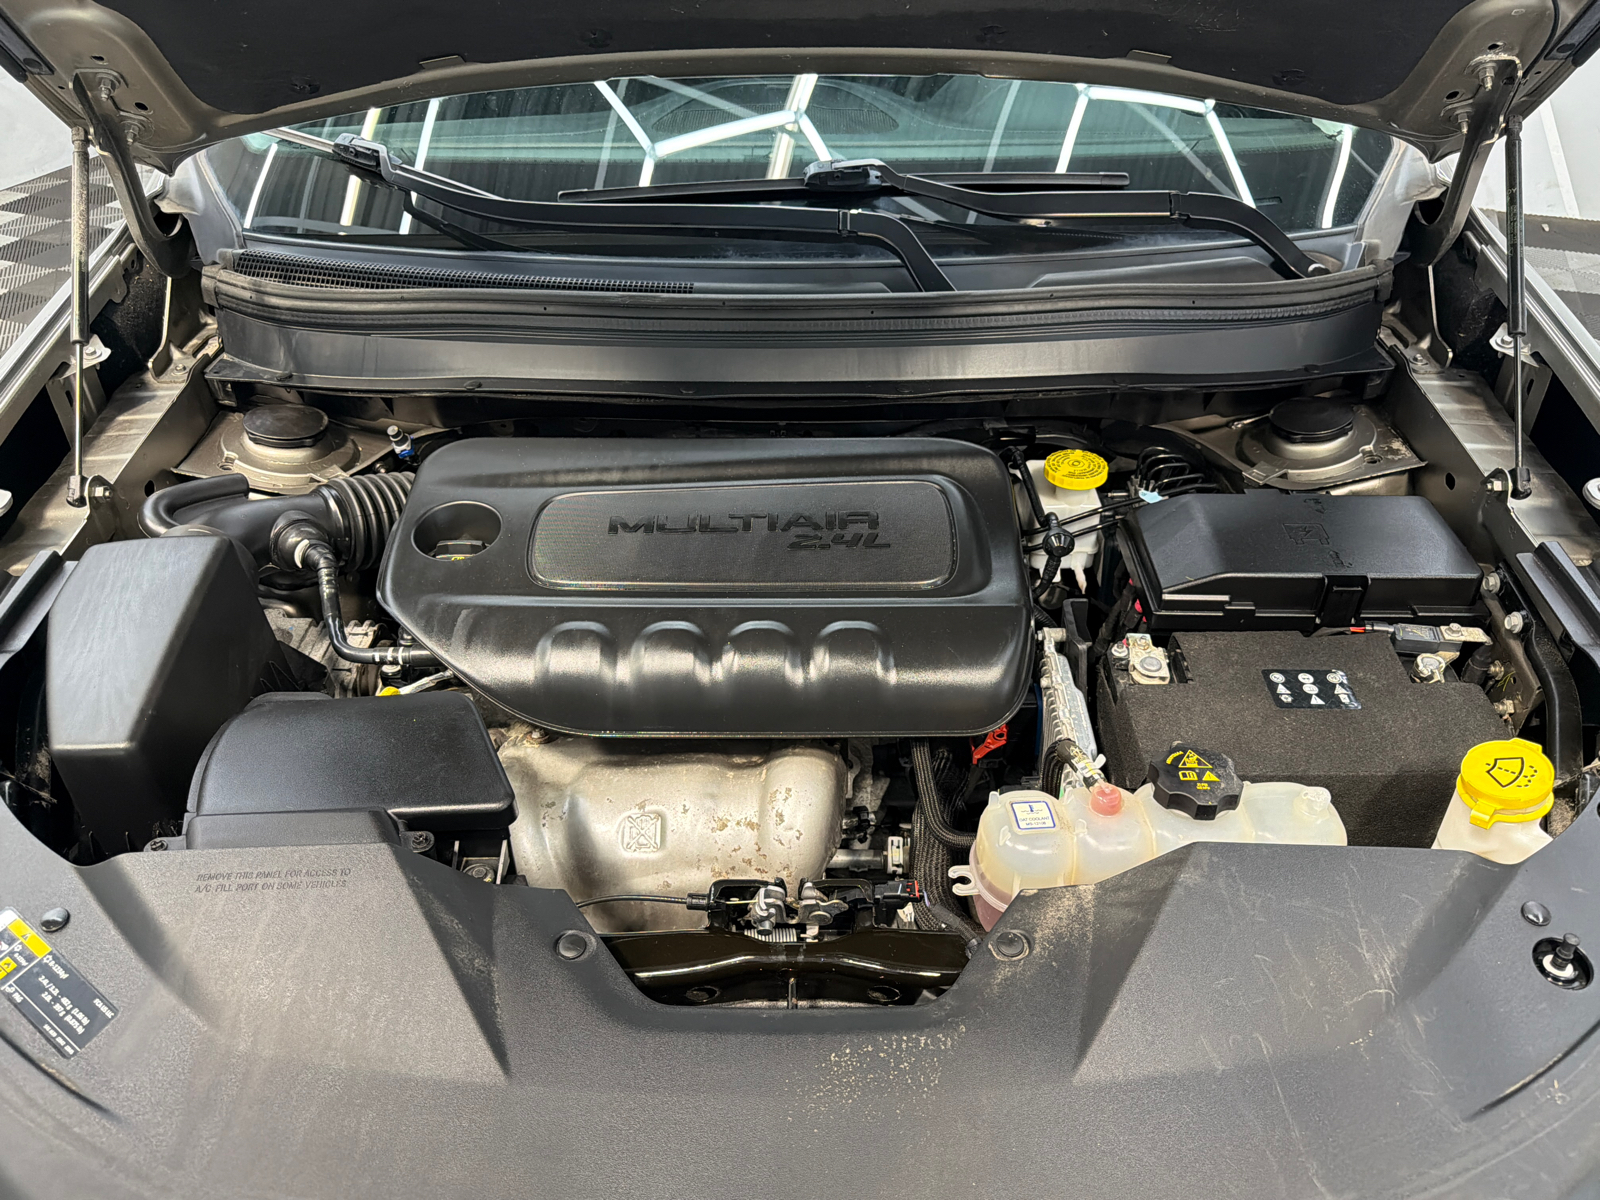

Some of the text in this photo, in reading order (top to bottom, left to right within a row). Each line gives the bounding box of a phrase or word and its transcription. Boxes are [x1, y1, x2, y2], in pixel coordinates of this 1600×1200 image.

[608, 510, 879, 535] MULTIAIR
[787, 532, 891, 549] 2.4L
[196, 867, 351, 881] REMOVE THIS PANEL FOR ACCESS TO
[194, 879, 347, 893] A/C FILL PORT ON SOME VEHICLES
